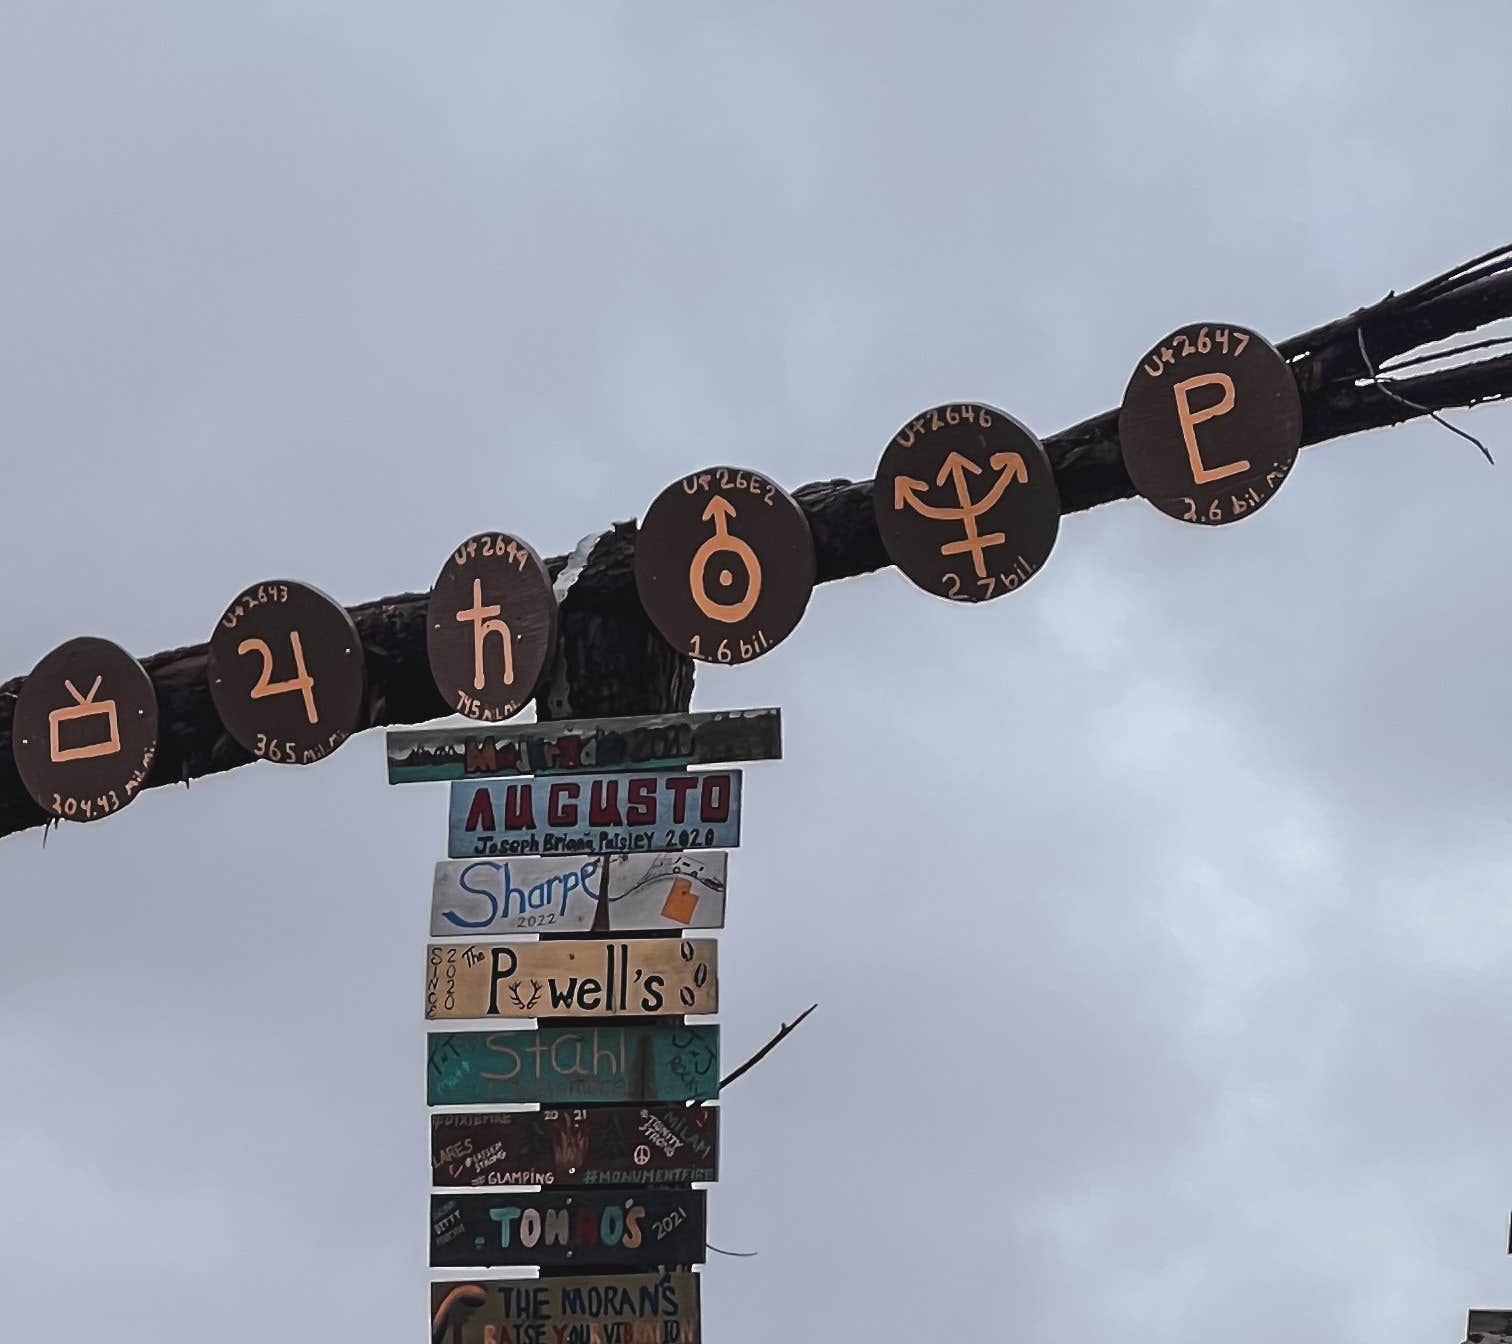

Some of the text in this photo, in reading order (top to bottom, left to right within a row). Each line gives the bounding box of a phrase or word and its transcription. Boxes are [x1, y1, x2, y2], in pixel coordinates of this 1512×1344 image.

[254, 733, 297, 763] 365
[464, 774, 731, 834] AUGUSTO
[665, 828, 715, 848] 2020
[441, 859, 601, 929] Sharpe
[517, 913, 558, 929] 2022
[462, 944, 486, 969] The
[480, 1027, 626, 1081] Stahl
[650, 1206, 689, 1242] 2021
[497, 1286, 552, 1321] THE
